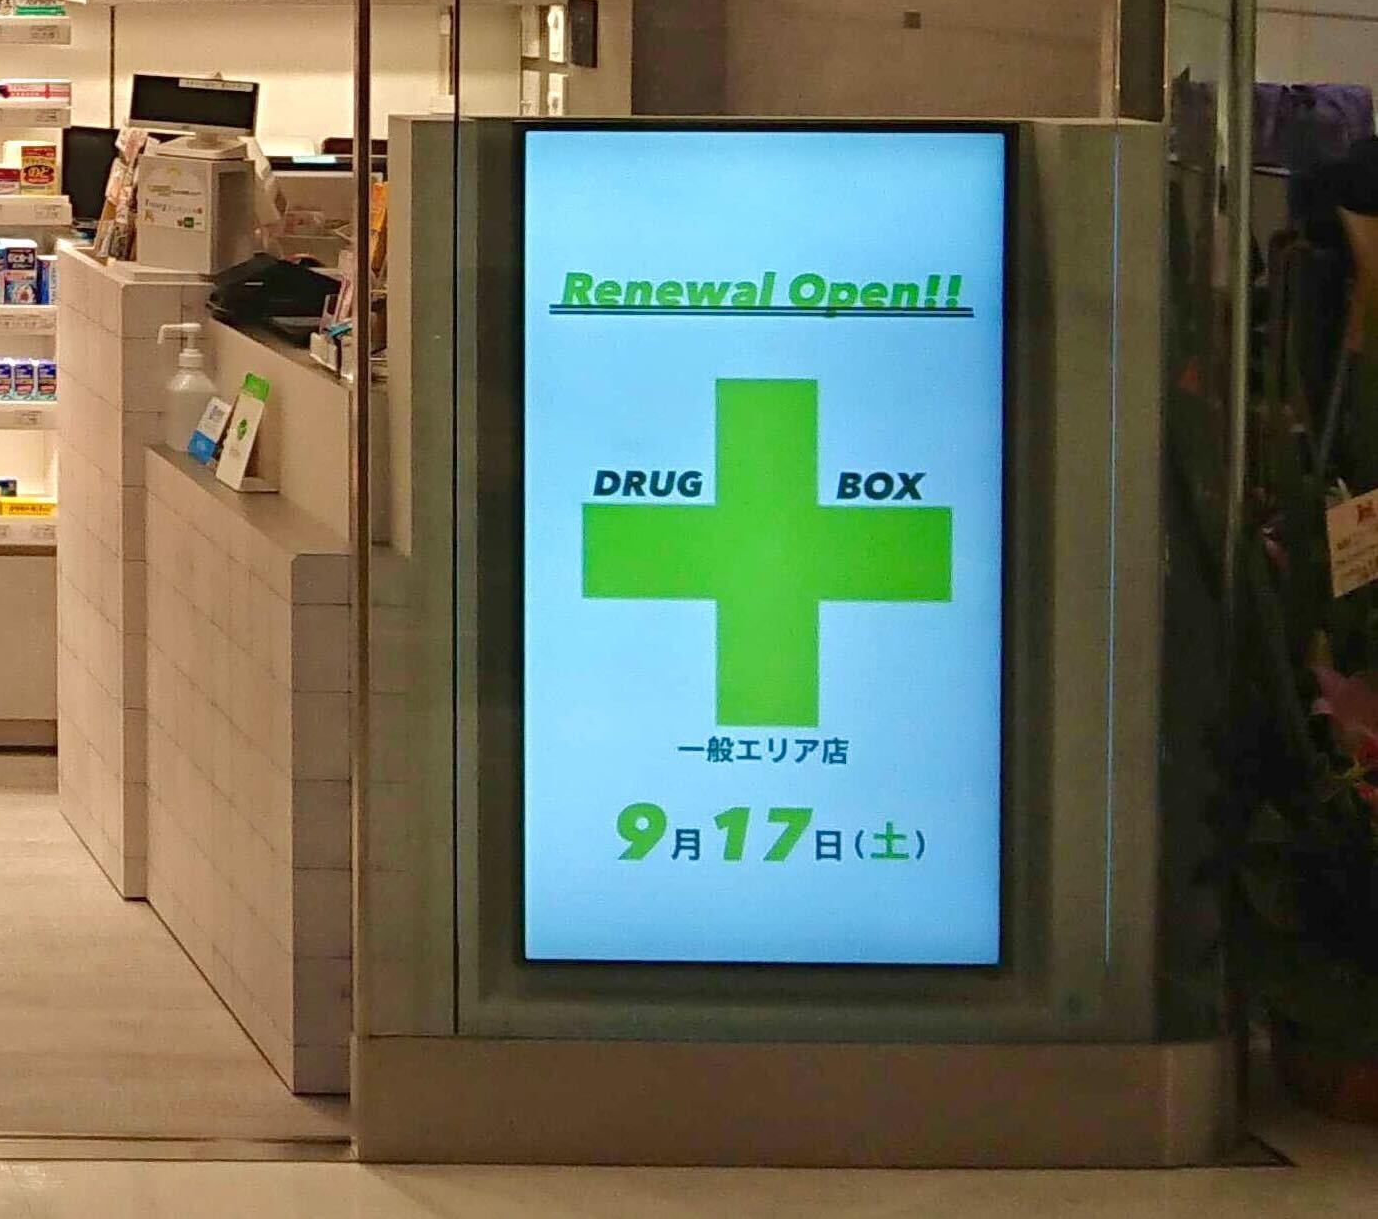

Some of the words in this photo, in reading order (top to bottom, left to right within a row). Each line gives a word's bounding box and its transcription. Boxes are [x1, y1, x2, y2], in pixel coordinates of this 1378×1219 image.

[560, 270, 775, 310] Renewal
[788, 273, 964, 318] Open!!
[593, 469, 704, 499] DRUG
[836, 471, 926, 501] BOX
[676, 735, 850, 767] 一般エリア店
